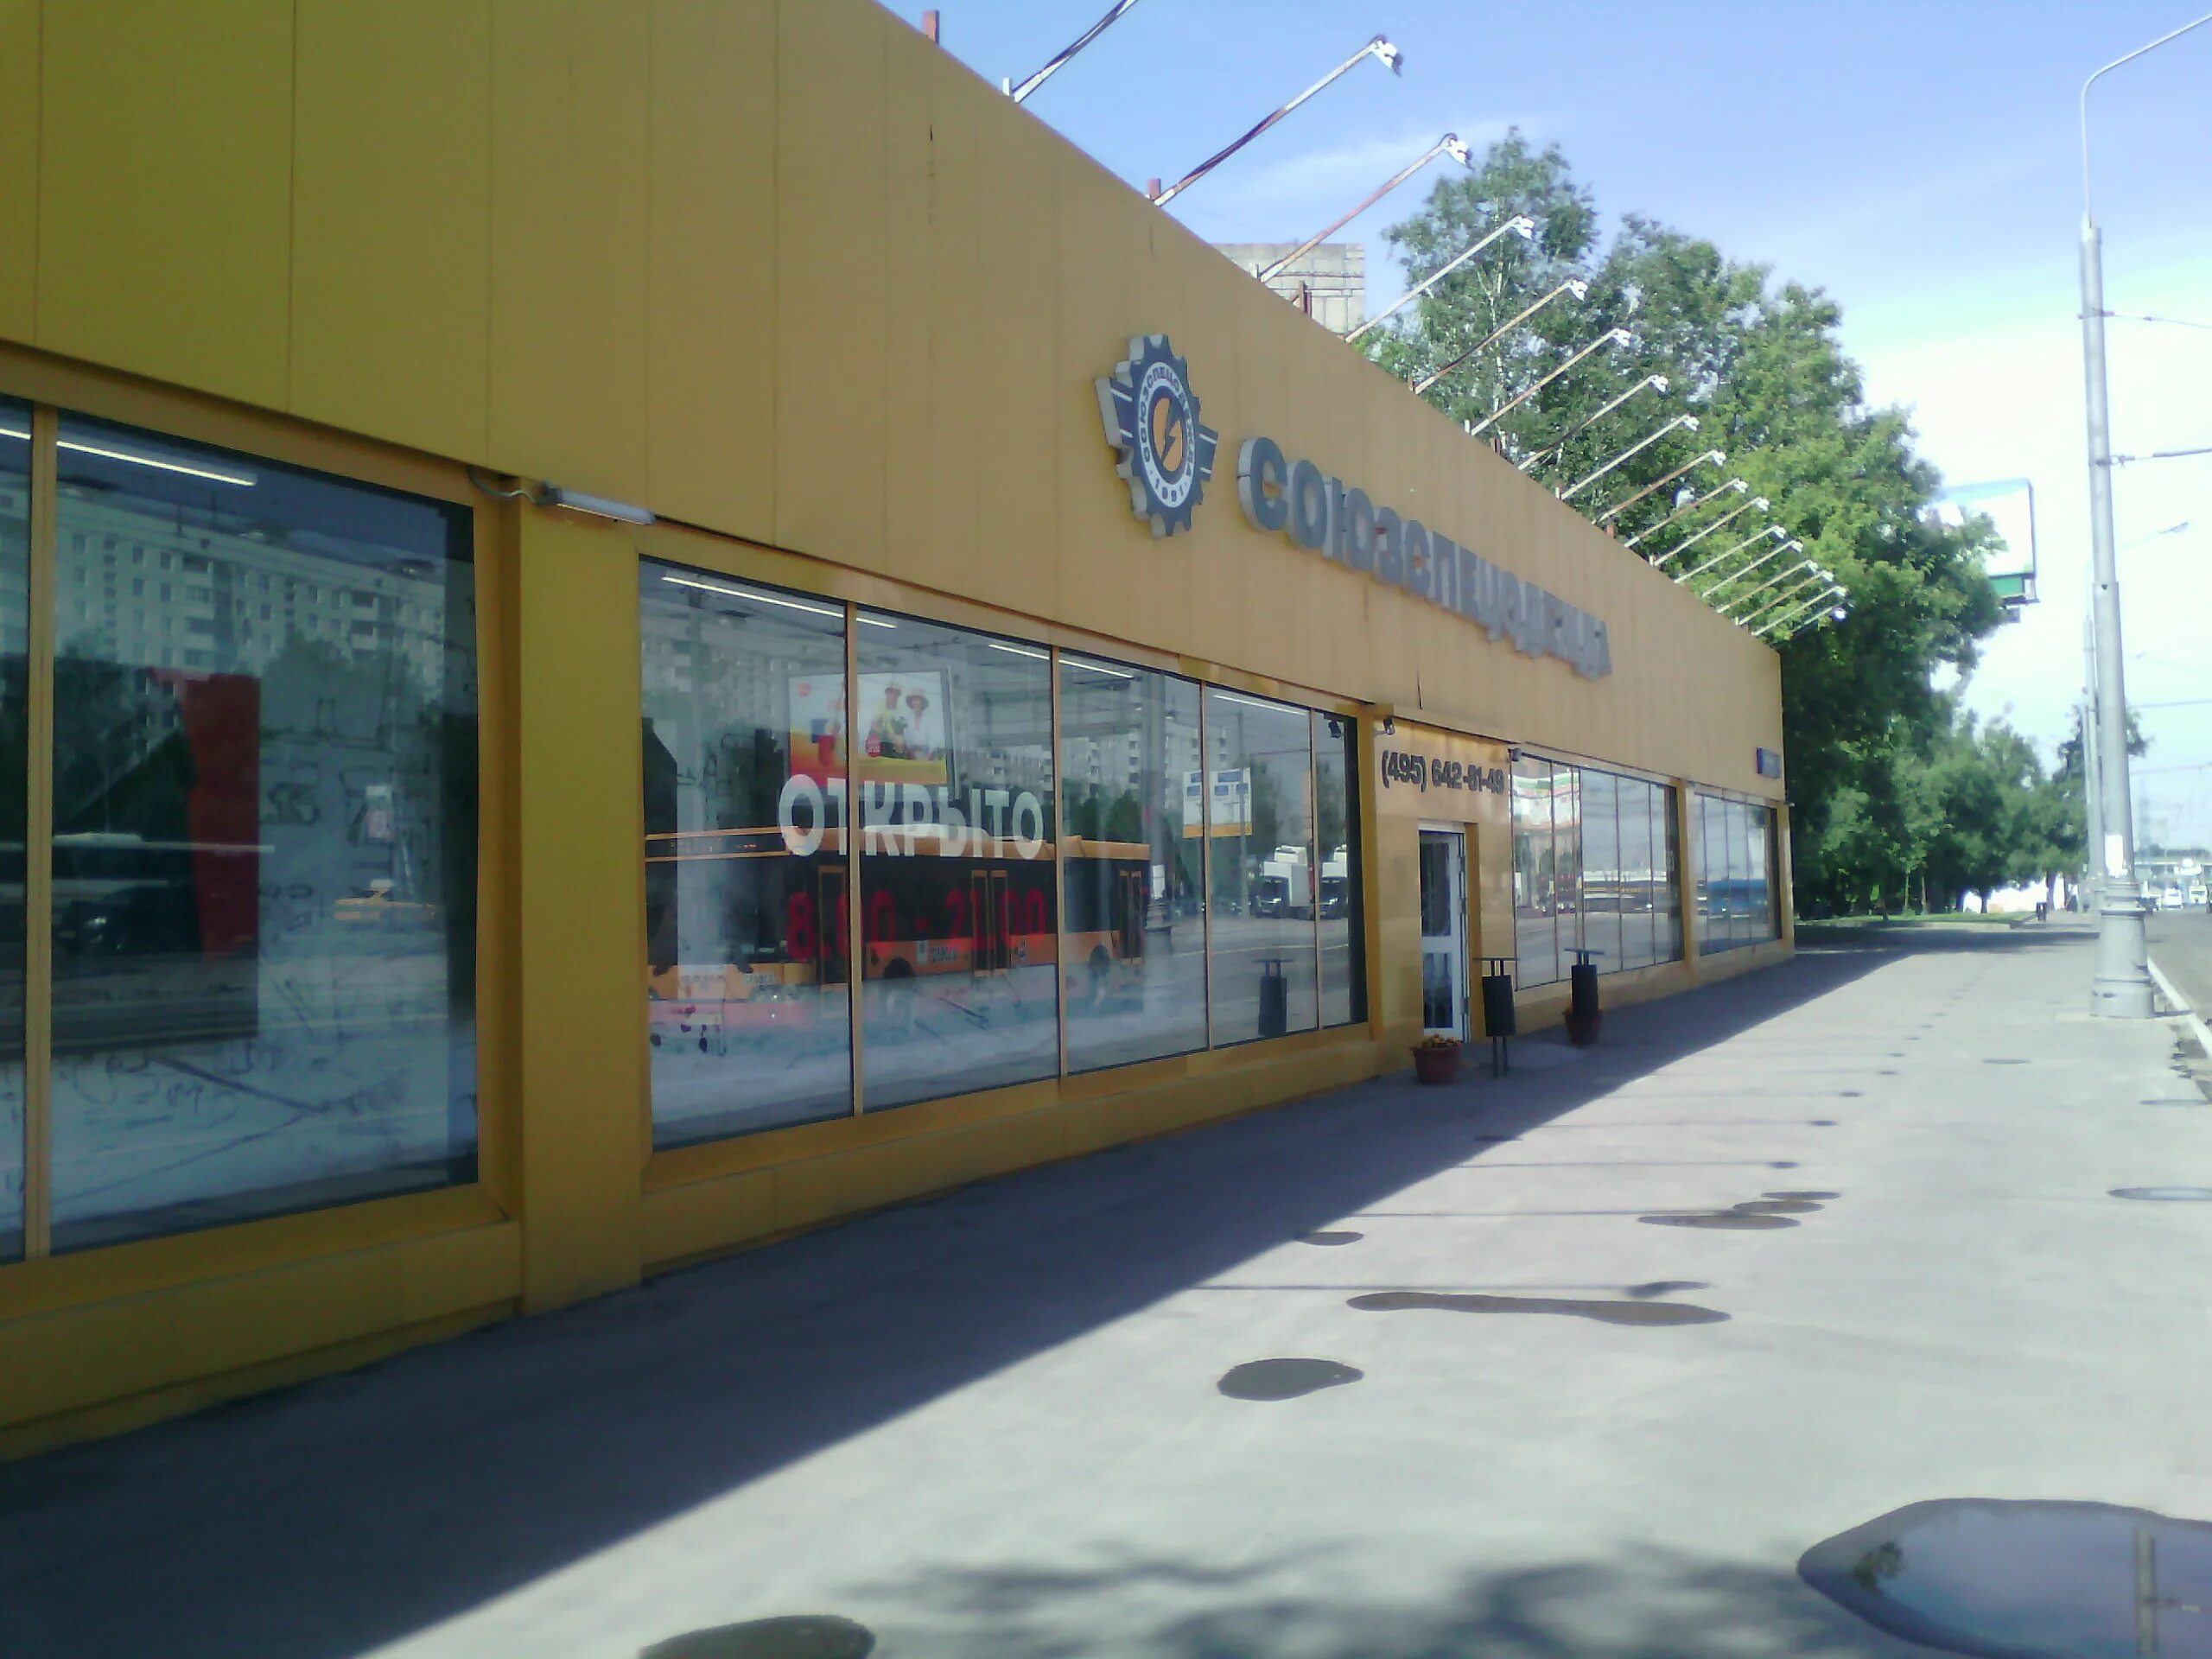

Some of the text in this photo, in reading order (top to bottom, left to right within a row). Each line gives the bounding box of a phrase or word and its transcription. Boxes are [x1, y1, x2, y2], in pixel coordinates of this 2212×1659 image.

[1382, 750, 1504, 794] (495) 642-81-49
[779, 774, 1044, 860] ОТКРЫТО
